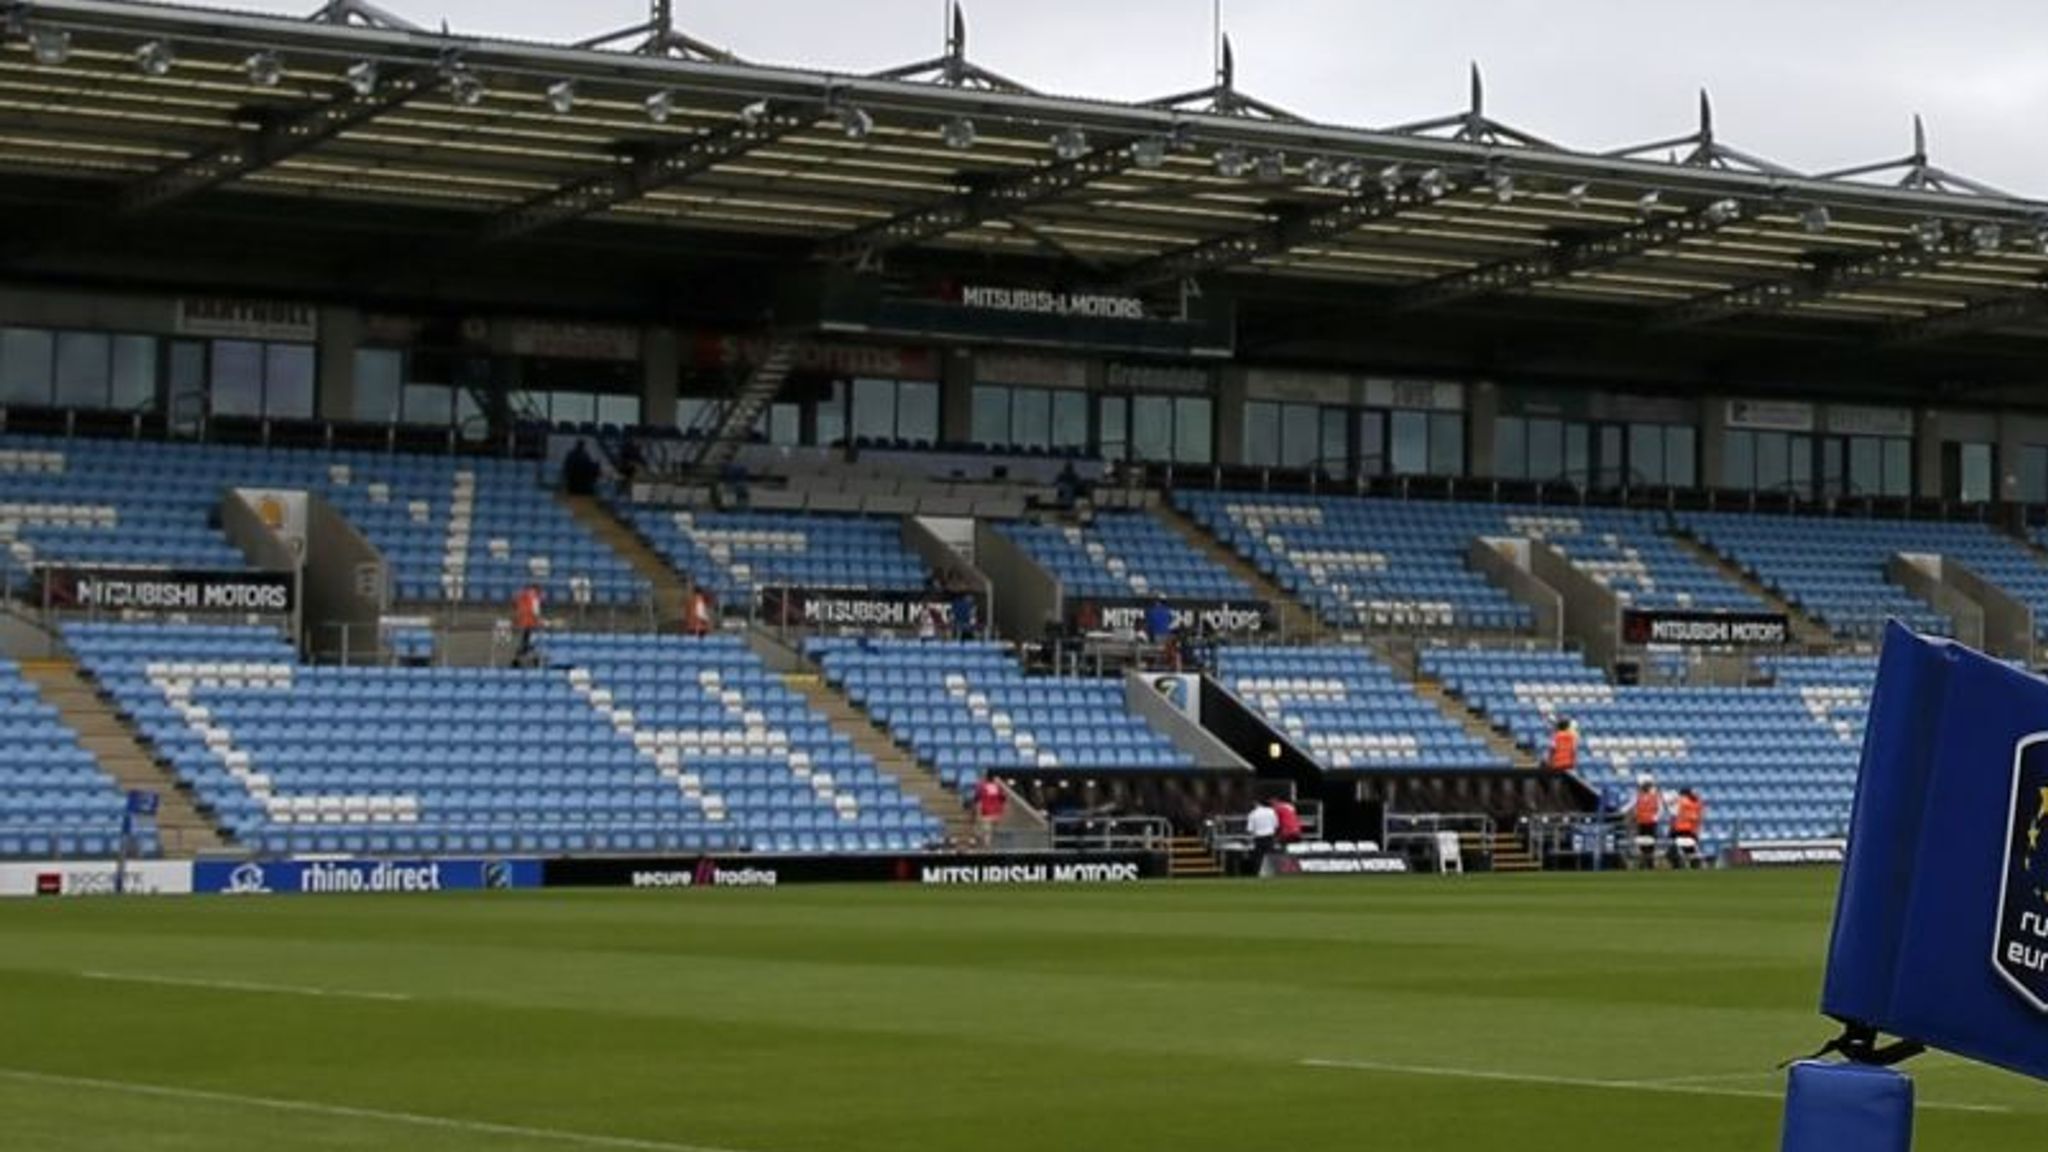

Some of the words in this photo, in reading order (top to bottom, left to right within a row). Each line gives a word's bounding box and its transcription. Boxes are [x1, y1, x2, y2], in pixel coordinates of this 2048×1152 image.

[961, 284, 1064, 314] MITSUBISHI
[1066, 294, 1144, 320] MOTORS
[76, 579, 197, 606] MITSUBISHI
[203, 583, 287, 608] MOTORS
[803, 599, 904, 623] MITSUBISHI
[302, 862, 440, 892] rhino.direct
[632, 870, 693, 886] secure
[713, 867, 777, 889] trading
[921, 864, 1048, 884] MITSUBISHI
[1054, 864, 1141, 883] MOTORS
